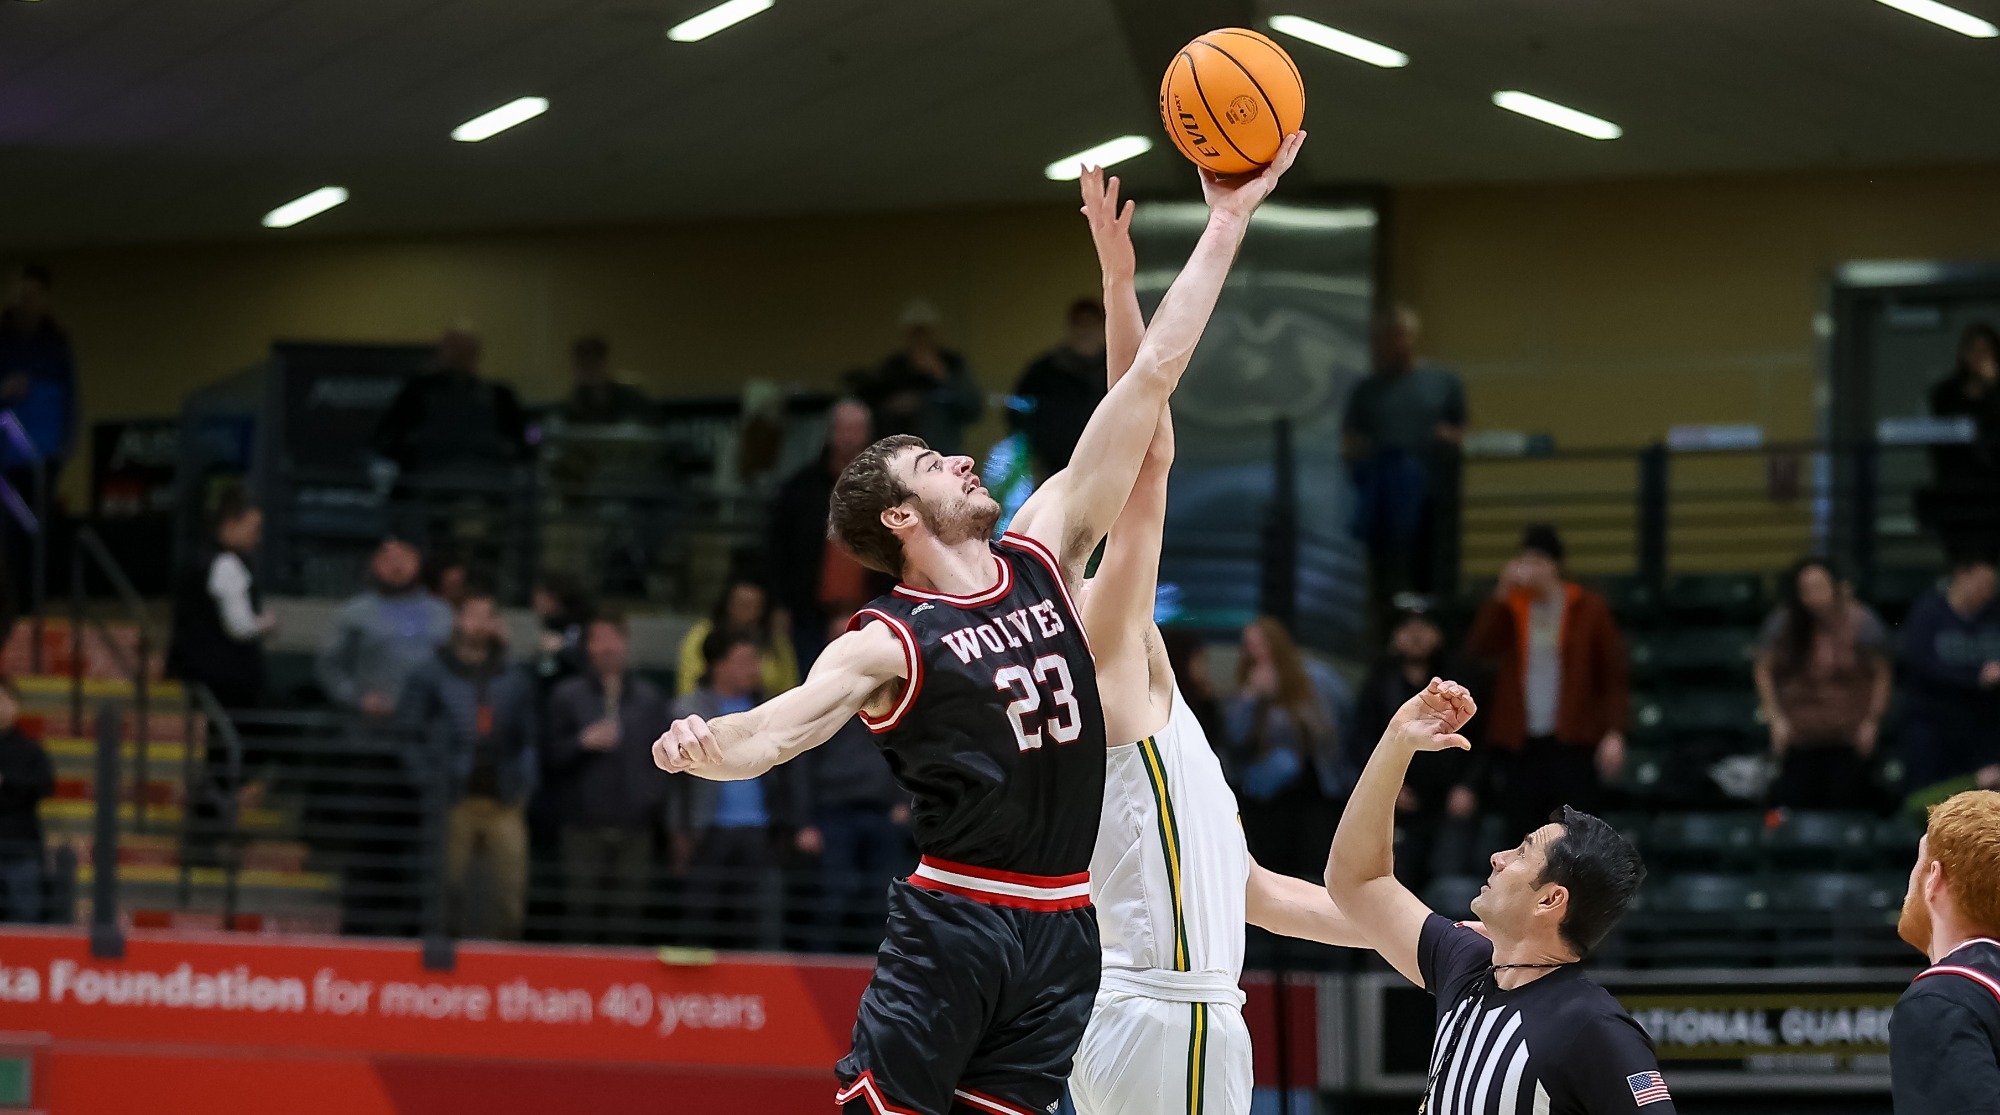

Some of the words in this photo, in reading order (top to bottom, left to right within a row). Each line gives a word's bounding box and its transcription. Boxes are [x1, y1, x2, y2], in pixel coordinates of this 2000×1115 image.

[1179, 113, 1221, 157] EVO
[940, 598, 1065, 665] WOLVES
[992, 652, 1082, 752] 23
[50, 959, 307, 1012] Foundation
[313, 968, 372, 1015] for
[379, 981, 492, 1021] more
[497, 977, 593, 1024] than
[600, 982, 654, 1027] 40
[657, 993, 766, 1037] years
